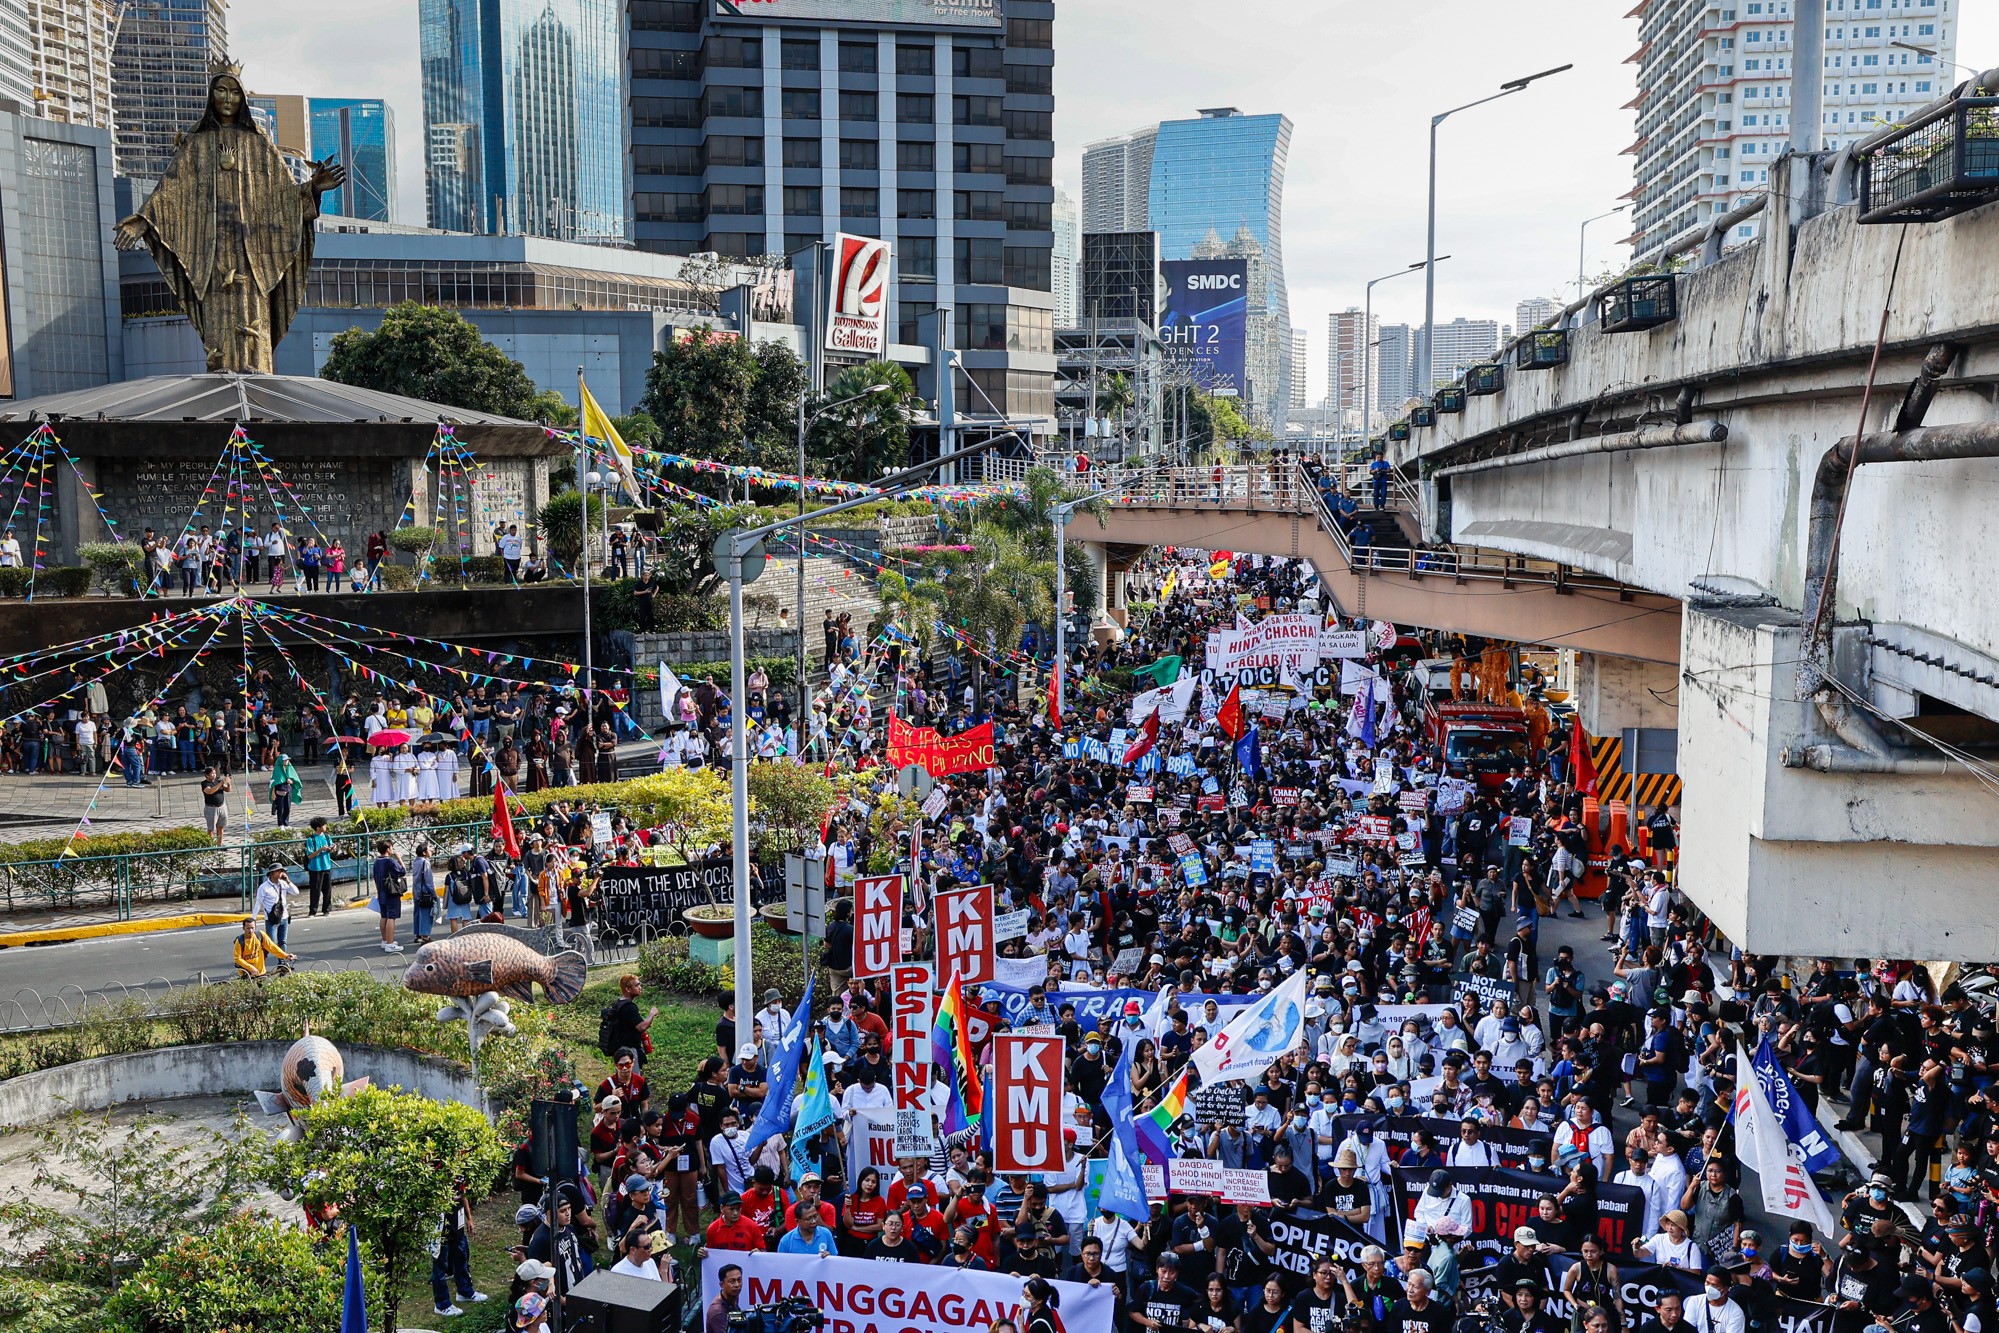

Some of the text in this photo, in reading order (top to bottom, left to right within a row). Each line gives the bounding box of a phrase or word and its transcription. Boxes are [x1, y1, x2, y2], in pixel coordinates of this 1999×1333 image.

[1187, 274, 1241, 290] SMDC
[834, 316, 879, 331] ROBINSONS
[832, 327, 878, 350] Galleria
[1207, 324, 1220, 344] 2
[160, 462, 174, 470] MY
[179, 461, 215, 470] PEOPLE
[302, 462, 315, 470] MY
[319, 461, 344, 469] NAME
[136, 473, 174, 481] HUMBLE
[243, 473, 261, 481] AND
[292, 473, 311, 481] AND
[314, 472, 336, 481] SEEK
[137, 484, 151, 492] MY
[183, 483, 203, 492] AND
[296, 483, 330, 491] WICKED
[138, 495, 164, 503] WAYS
[169, 494, 194, 503] THEN
[326, 493, 345, 501] AND
[339, 503, 363, 511] LAND
[1264, 624, 1318, 641] CHACHA!
[1339, 641, 1360, 649] LUPA!
[1064, 743, 1079, 758] NO
[1166, 756, 1192, 776] BBM
[1273, 788, 1298, 797] CHAKA
[1253, 847, 1273, 855] KONTRA
[601, 878, 640, 895] FROM
[645, 874, 671, 892] THE
[619, 895, 646, 911] THE
[651, 888, 707, 909] FILIPINO
[862, 879, 893, 972] KMU
[947, 890, 983, 983] KMU
[1471, 974, 1497, 988] NOT
[1459, 981, 1512, 1001] THROUGH
[1388, 1015, 1408, 1023] 1987
[895, 967, 930, 1112] PSLINK
[1007, 1041, 1050, 1167] KMU
[896, 1120, 920, 1128] SERVICES
[896, 1127, 913, 1135] LABOR
[896, 1135, 929, 1143] INDEPENDENT
[896, 1143, 932, 1152] CONFEDERATION
[1178, 1161, 1214, 1170] DAGDAG
[1171, 1170, 1222, 1180] SAHOD HINDI
[1245, 1172, 1264, 1180] WAGE
[1179, 1180, 1215, 1188] CHACHA!
[1226, 1178, 1260, 1186] INCREASE!
[1241, 1186, 1265, 1194] MARCOS
[1456, 1183, 1477, 1194] lupa,
[1479, 1183, 1520, 1198] karapatan
[1521, 1188, 1531, 1198] at
[1232, 1191, 1258, 1199] CHACHA!
[1335, 1194, 1355, 1203] NEVER
